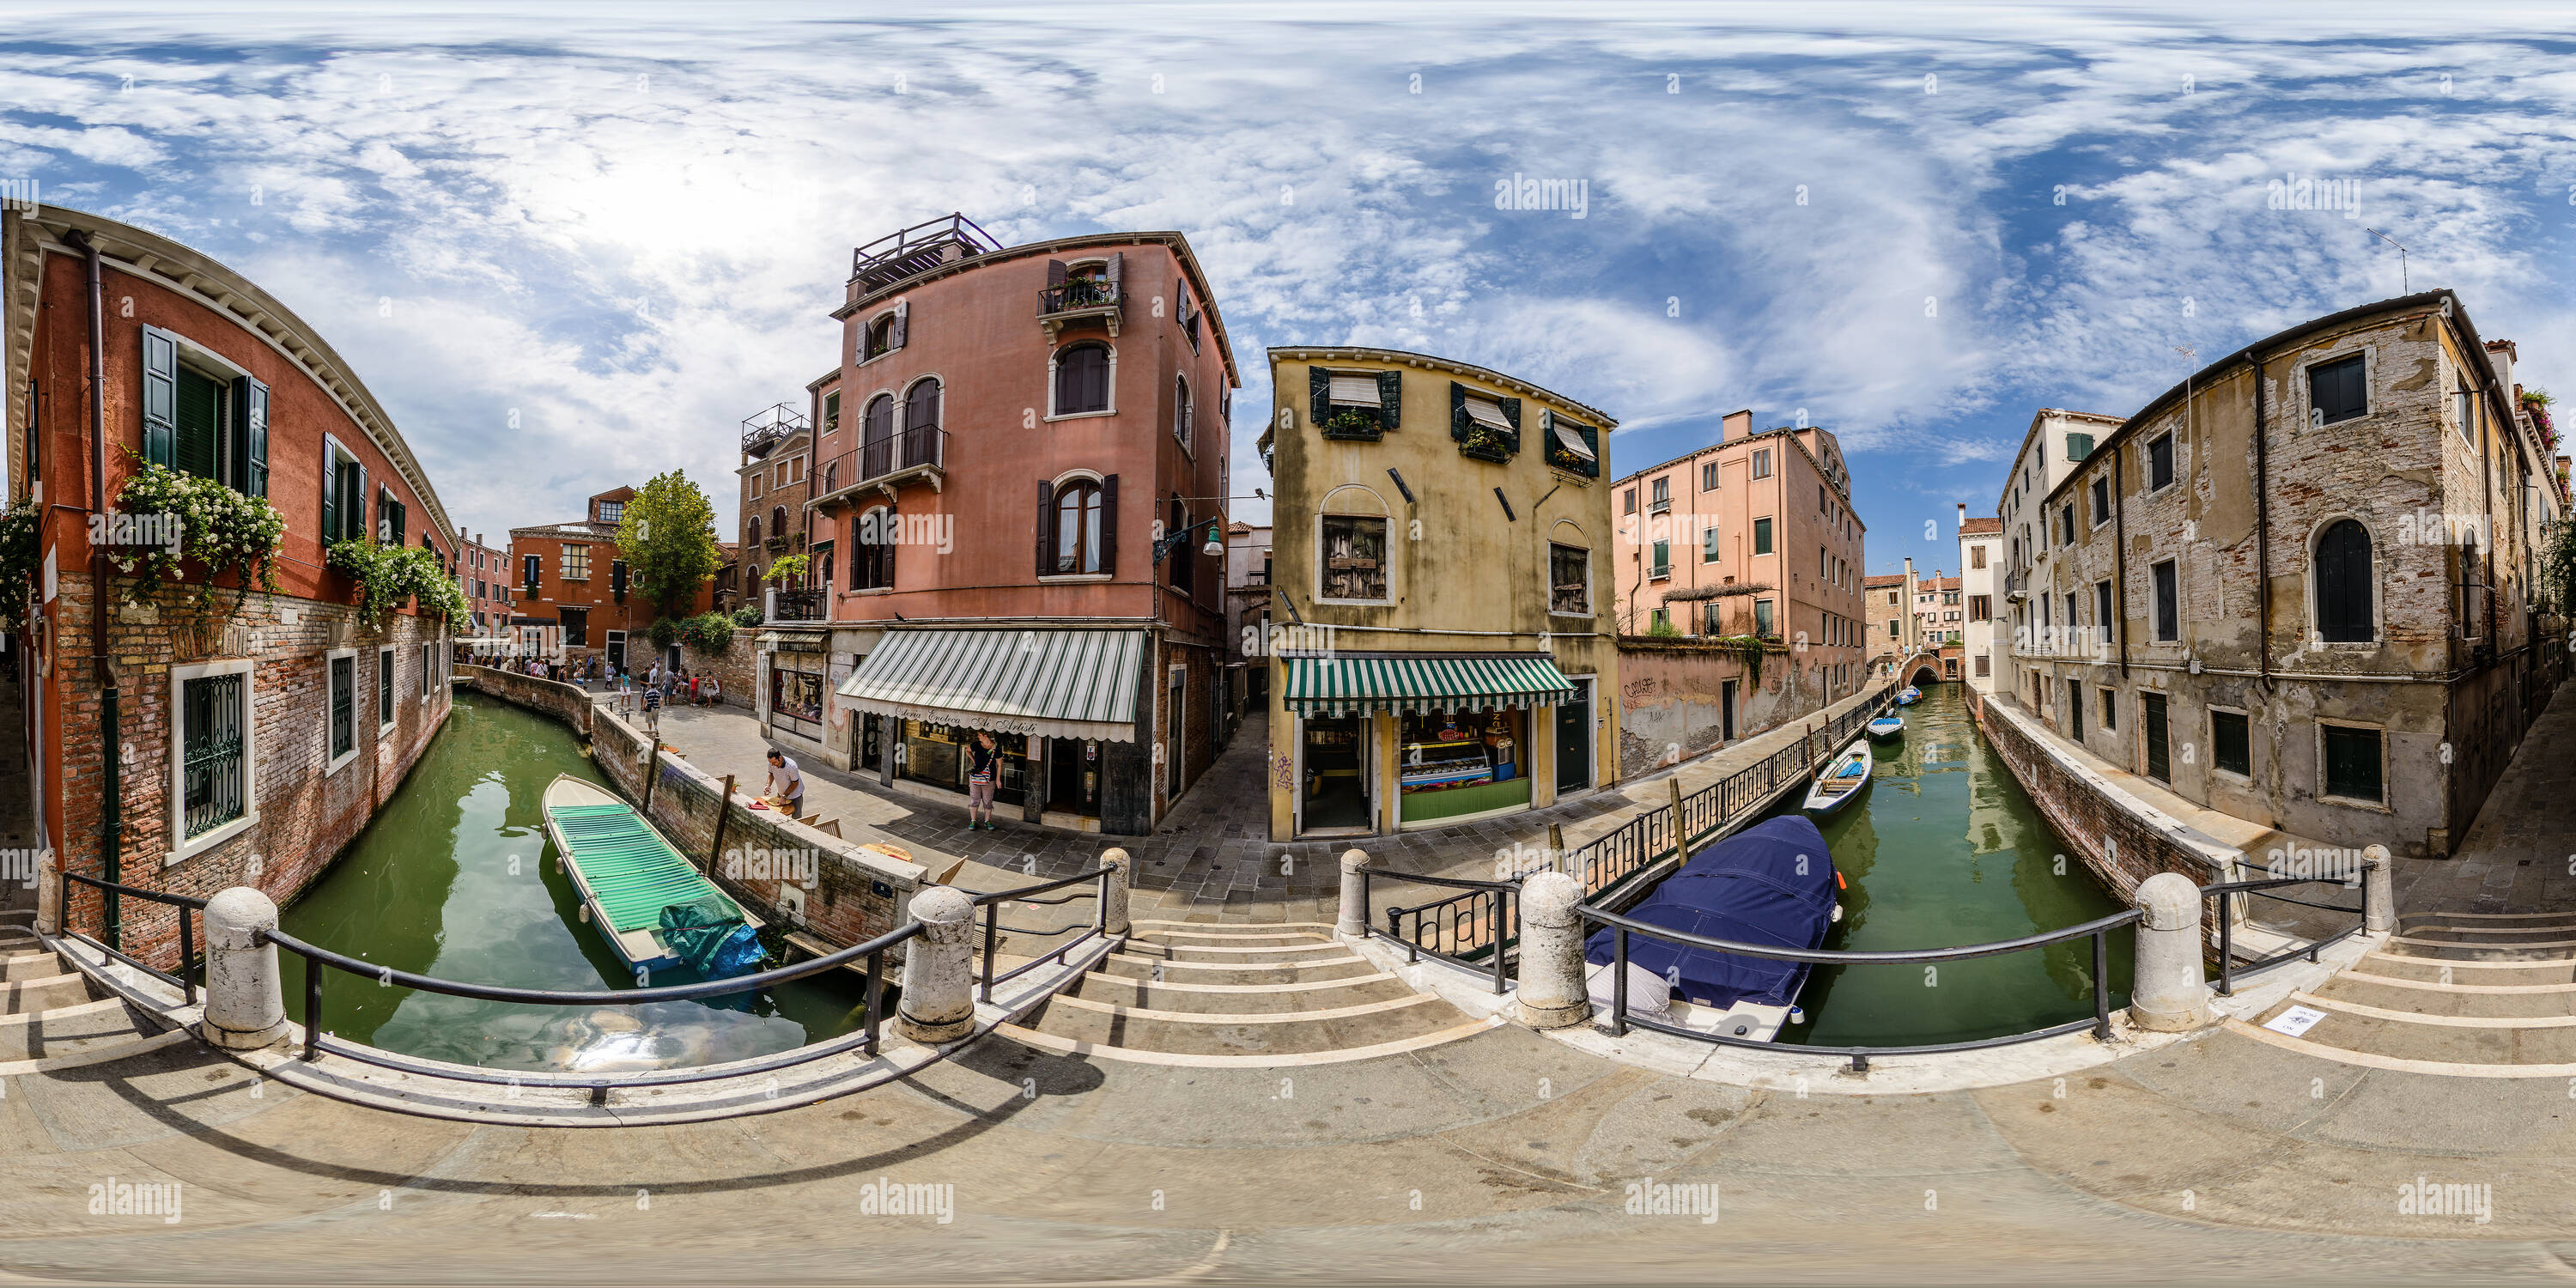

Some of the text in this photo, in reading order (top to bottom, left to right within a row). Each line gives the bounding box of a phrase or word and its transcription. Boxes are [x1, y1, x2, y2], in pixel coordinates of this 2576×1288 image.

[895, 706, 1037, 732] Osteria Enoteca Ai Artisti
